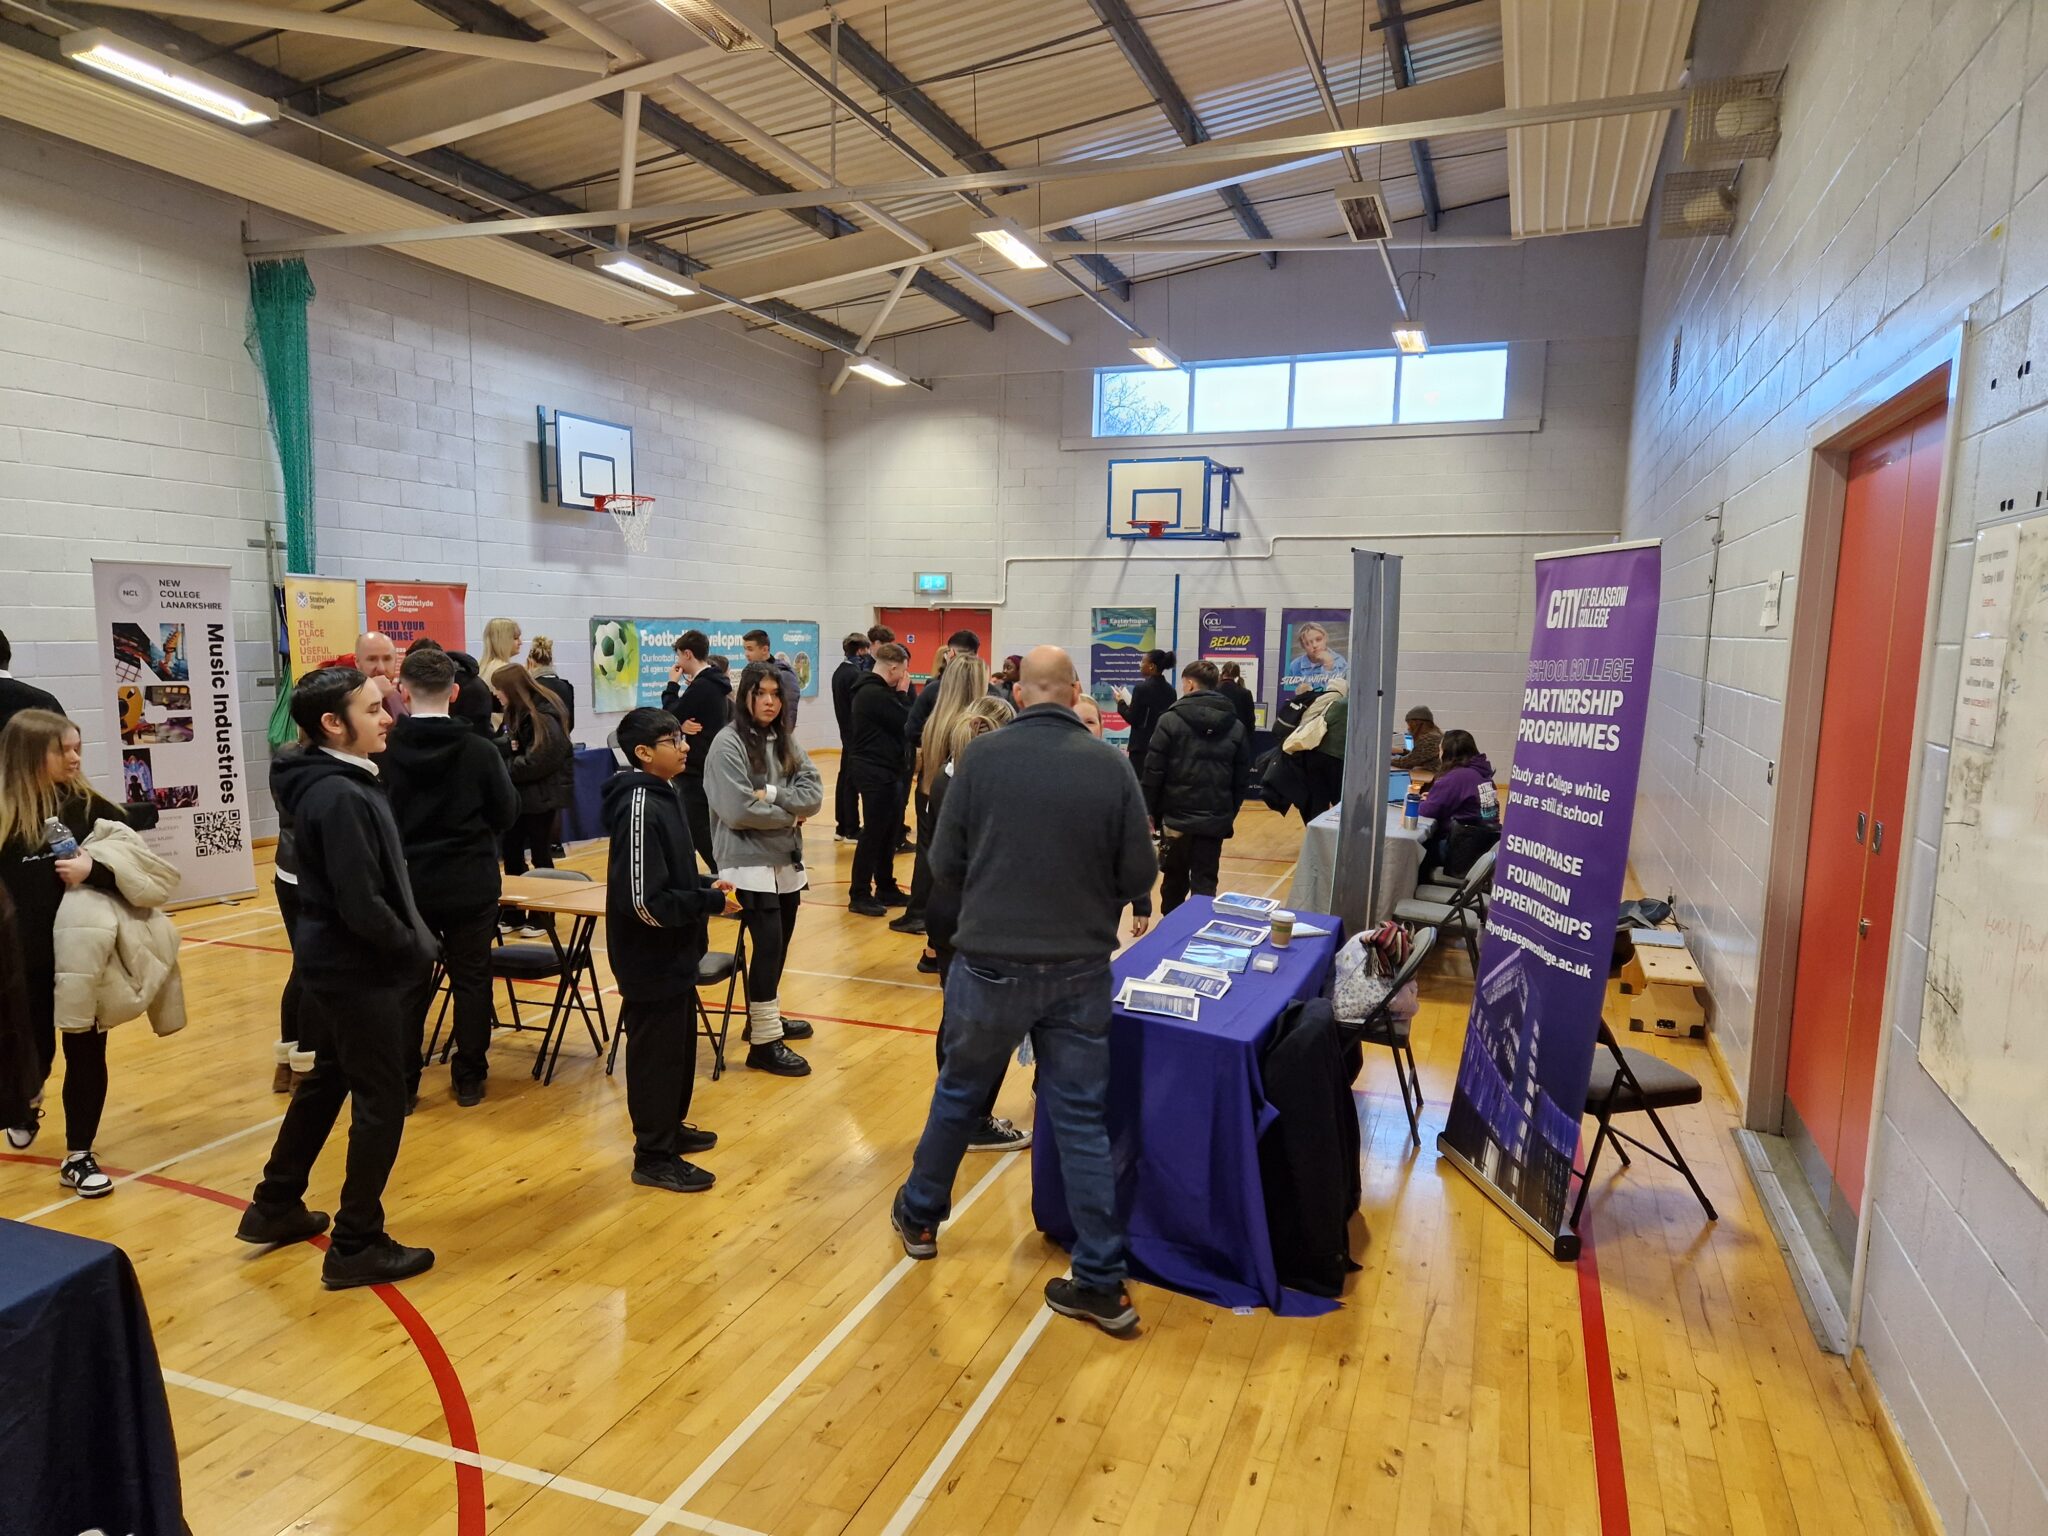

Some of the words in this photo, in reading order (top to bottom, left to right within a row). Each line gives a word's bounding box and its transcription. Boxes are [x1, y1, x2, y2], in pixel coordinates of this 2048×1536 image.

[158, 579, 181, 588] NEW
[122, 589, 139, 597] NCL
[159, 590, 200, 599] COLLEGE
[1581, 588, 1591, 607] OF
[1590, 586, 1629, 607] GLASGOW
[160, 601, 222, 610] LANARKSHIRE
[398, 600, 433, 608] Strathclyde
[297, 620, 315, 629] THE
[378, 621, 399, 630] FIND
[401, 621, 425, 630] YOUR
[1578, 608, 1611, 628] COLLEGE
[298, 629, 325, 637] PLACE
[300, 638, 312, 646] OF
[1209, 636, 1251, 648] BELONG
[206, 624, 230, 689] Music
[300, 647, 331, 655] USEFUL
[1526, 660, 1569, 682] SCHOOL
[1569, 658, 1635, 683] COLLEGE
[1280, 676, 1306, 685] STUDY
[1523, 688, 1624, 716] PARTNERSHIP
[1517, 718, 1621, 752] PROGRAMMES
[213, 694, 238, 804] Industries
[1511, 764, 1534, 786] Study
[1534, 772, 1545, 786] at
[1546, 772, 1573, 796] College
[1575, 782, 1611, 802] while
[1507, 790, 1523, 804] you
[1523, 794, 1539, 808] are
[1540, 797, 1557, 813] still
[1563, 805, 1604, 827] school
[1506, 834, 1547, 861] SENIOR
[1545, 848, 1584, 877] PHASE
[1506, 864, 1571, 906] FOUNDATION
[1490, 884, 1593, 941] APPRENTICESHIPS
